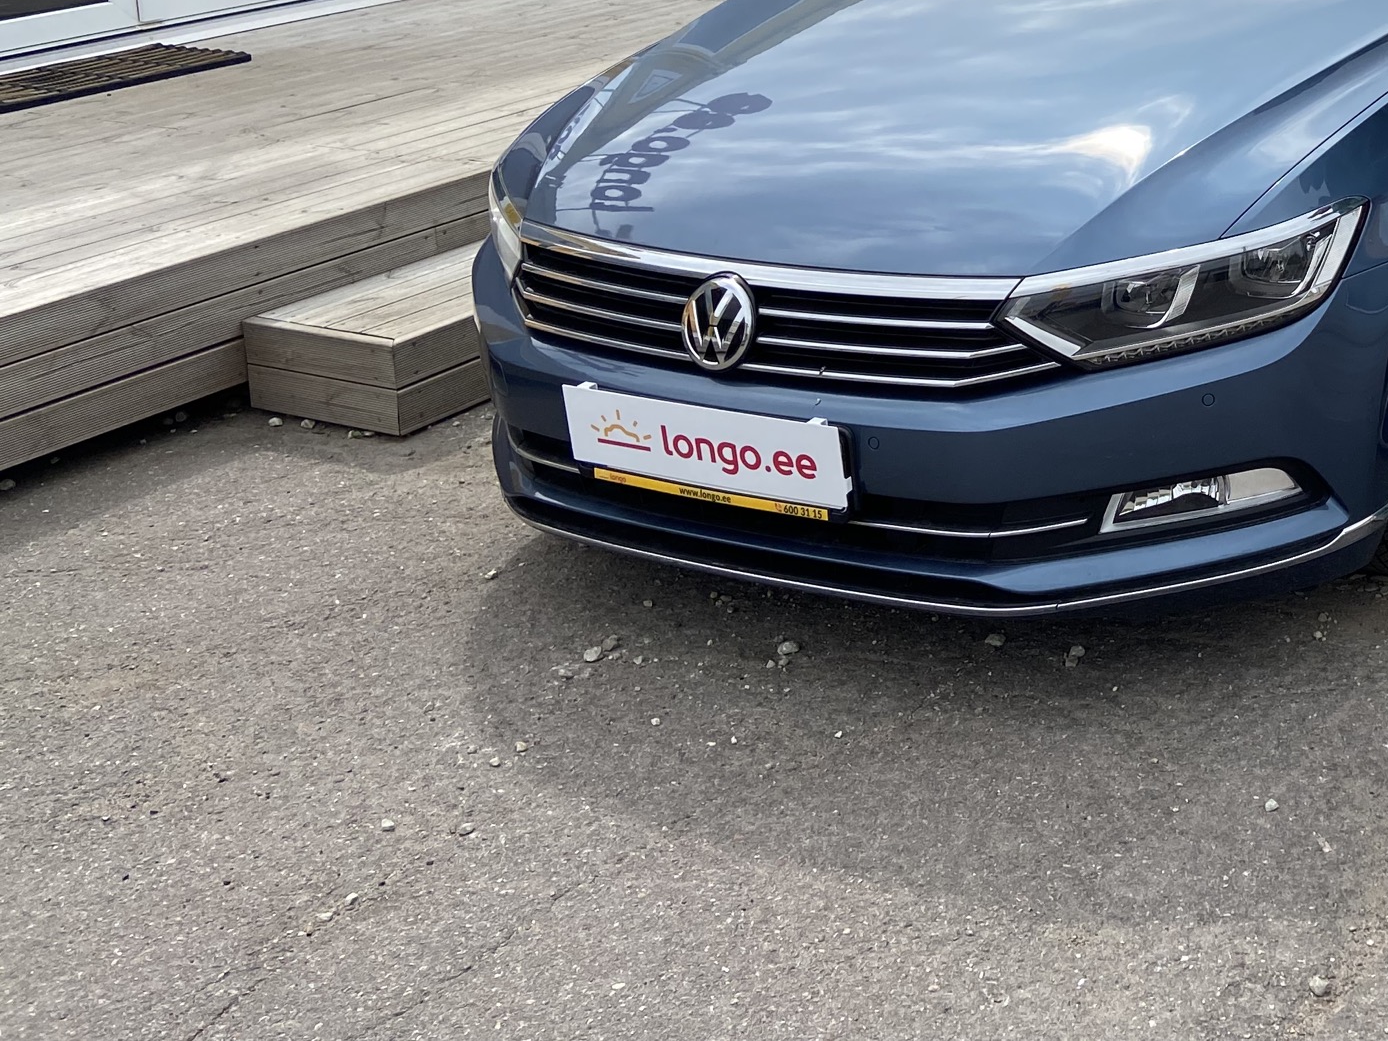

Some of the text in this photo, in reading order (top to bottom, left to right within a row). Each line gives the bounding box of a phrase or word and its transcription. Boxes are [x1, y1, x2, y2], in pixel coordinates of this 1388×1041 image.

[660, 424, 818, 480] longo.ee
[679, 487, 732, 503] www.longo.ee
[783, 504, 823, 519] 600 31 15
